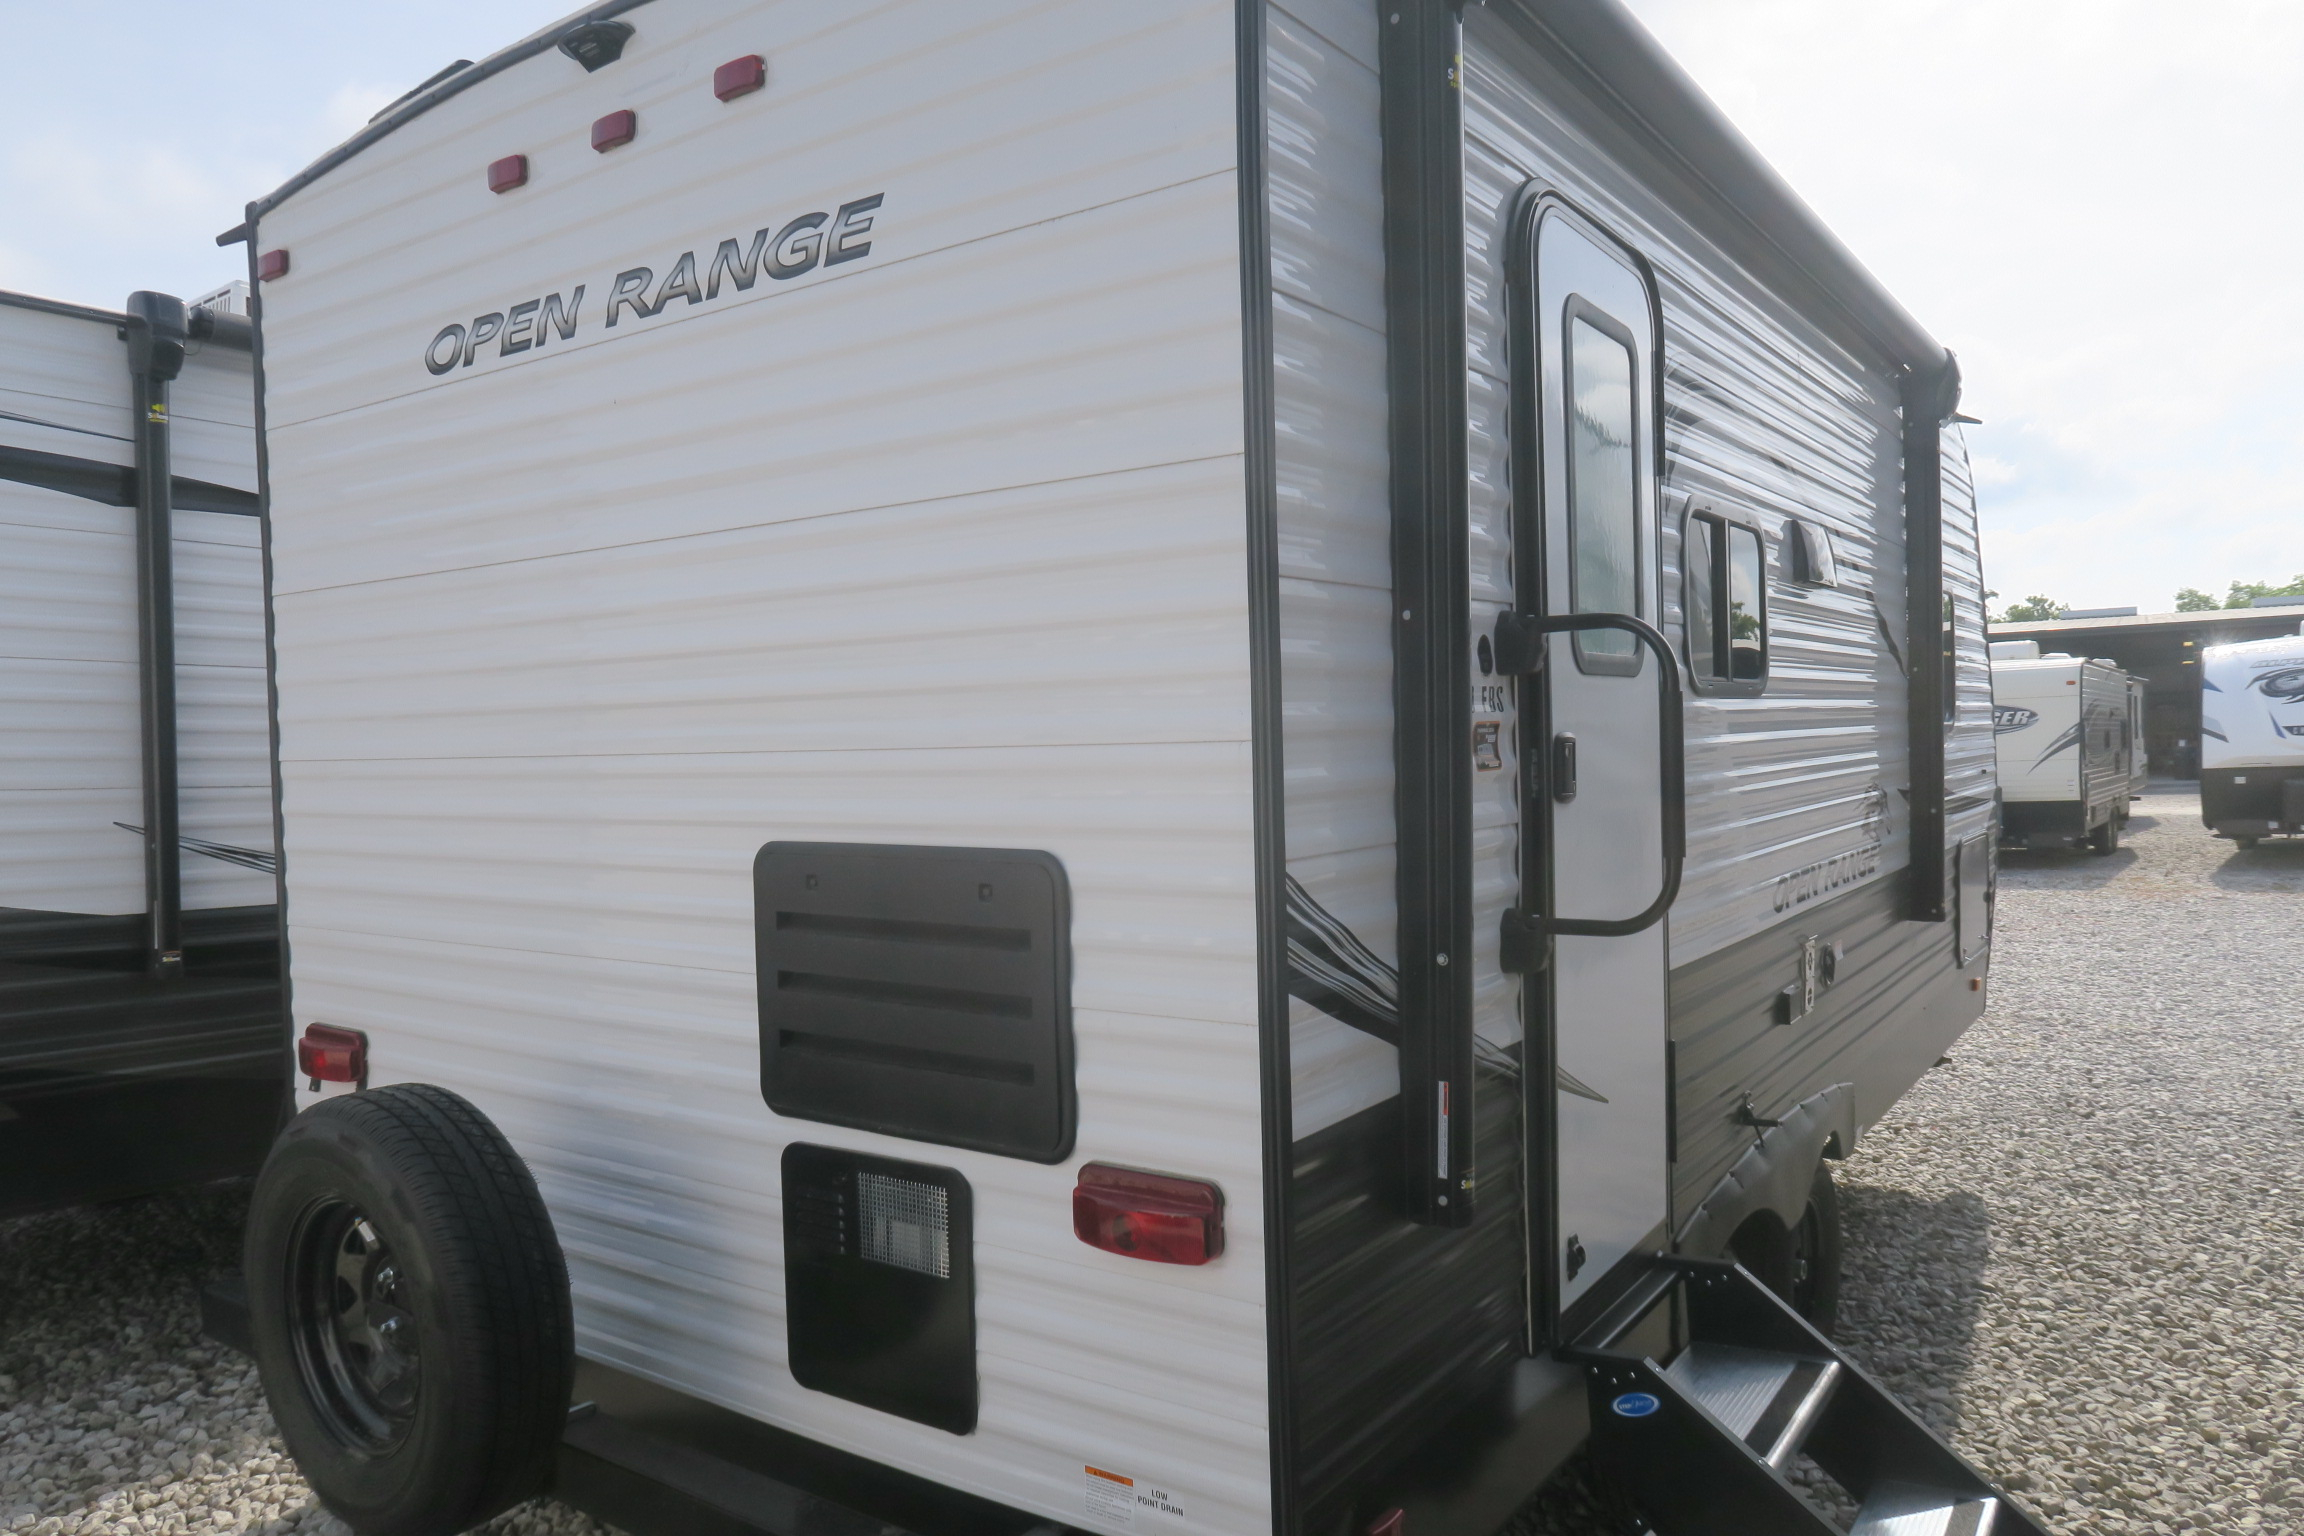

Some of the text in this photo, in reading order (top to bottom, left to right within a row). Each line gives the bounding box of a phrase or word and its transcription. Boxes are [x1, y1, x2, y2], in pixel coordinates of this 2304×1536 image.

[424, 192, 885, 376] OPEN RANGE
[1137, 1495, 1184, 1517] POINT DRAIN
[1151, 1489, 1168, 1501] LOW
